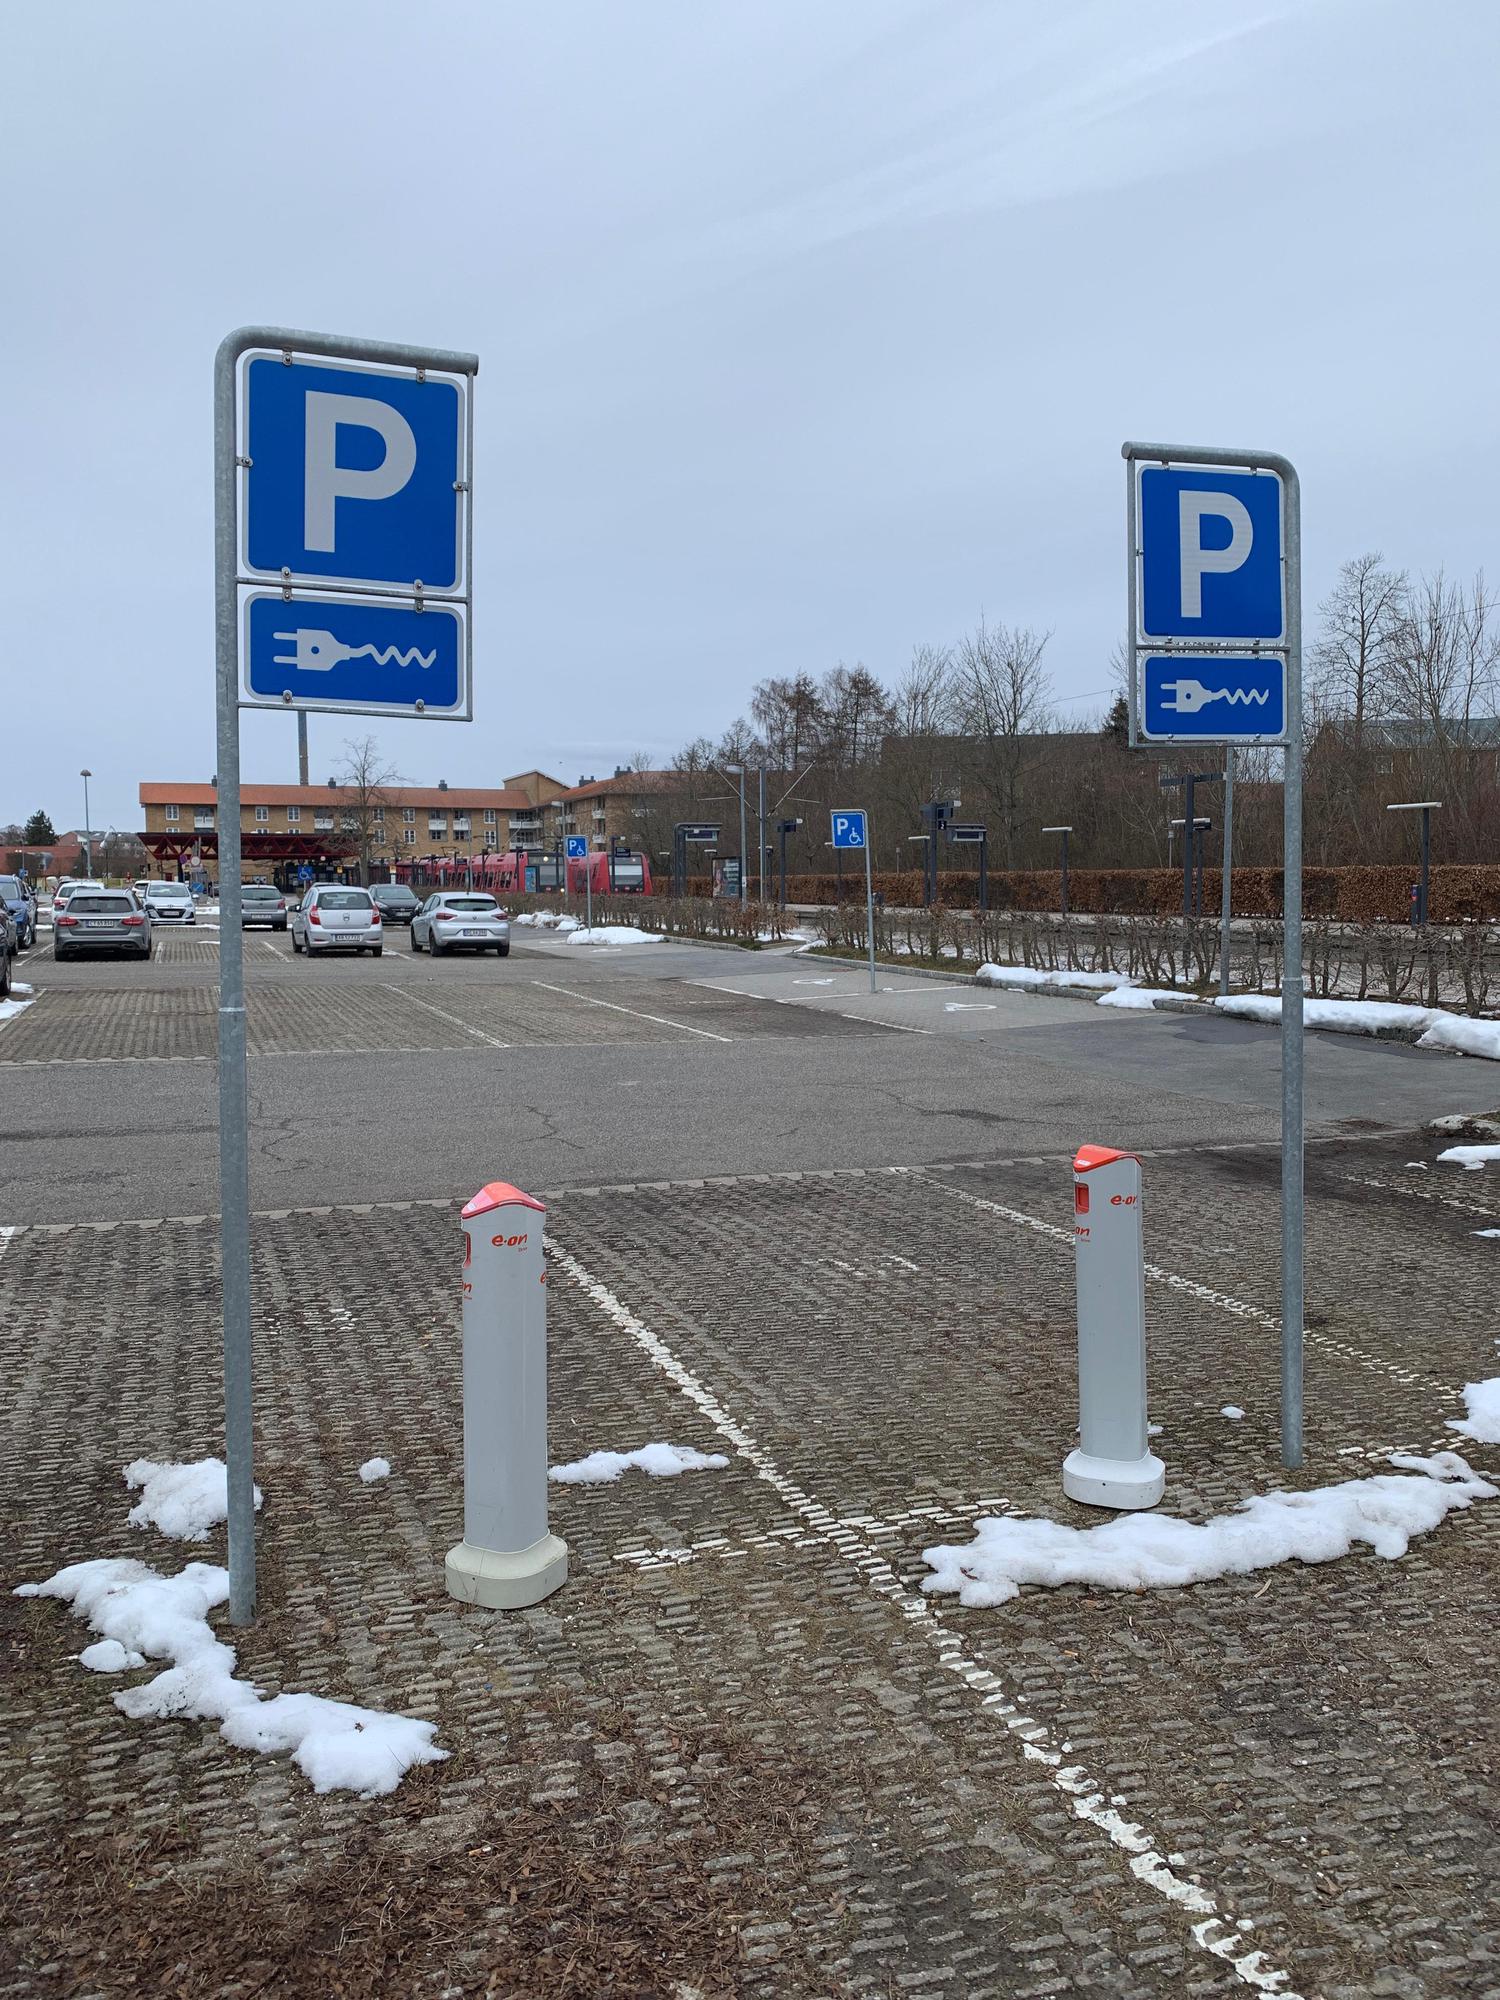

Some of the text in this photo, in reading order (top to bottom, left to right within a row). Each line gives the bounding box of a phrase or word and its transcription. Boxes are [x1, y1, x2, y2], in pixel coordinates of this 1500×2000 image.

[304, 390, 417, 553] P
[1179, 490, 1254, 618] P
[569, 839, 577, 851] P
[836, 818, 849, 836] P
